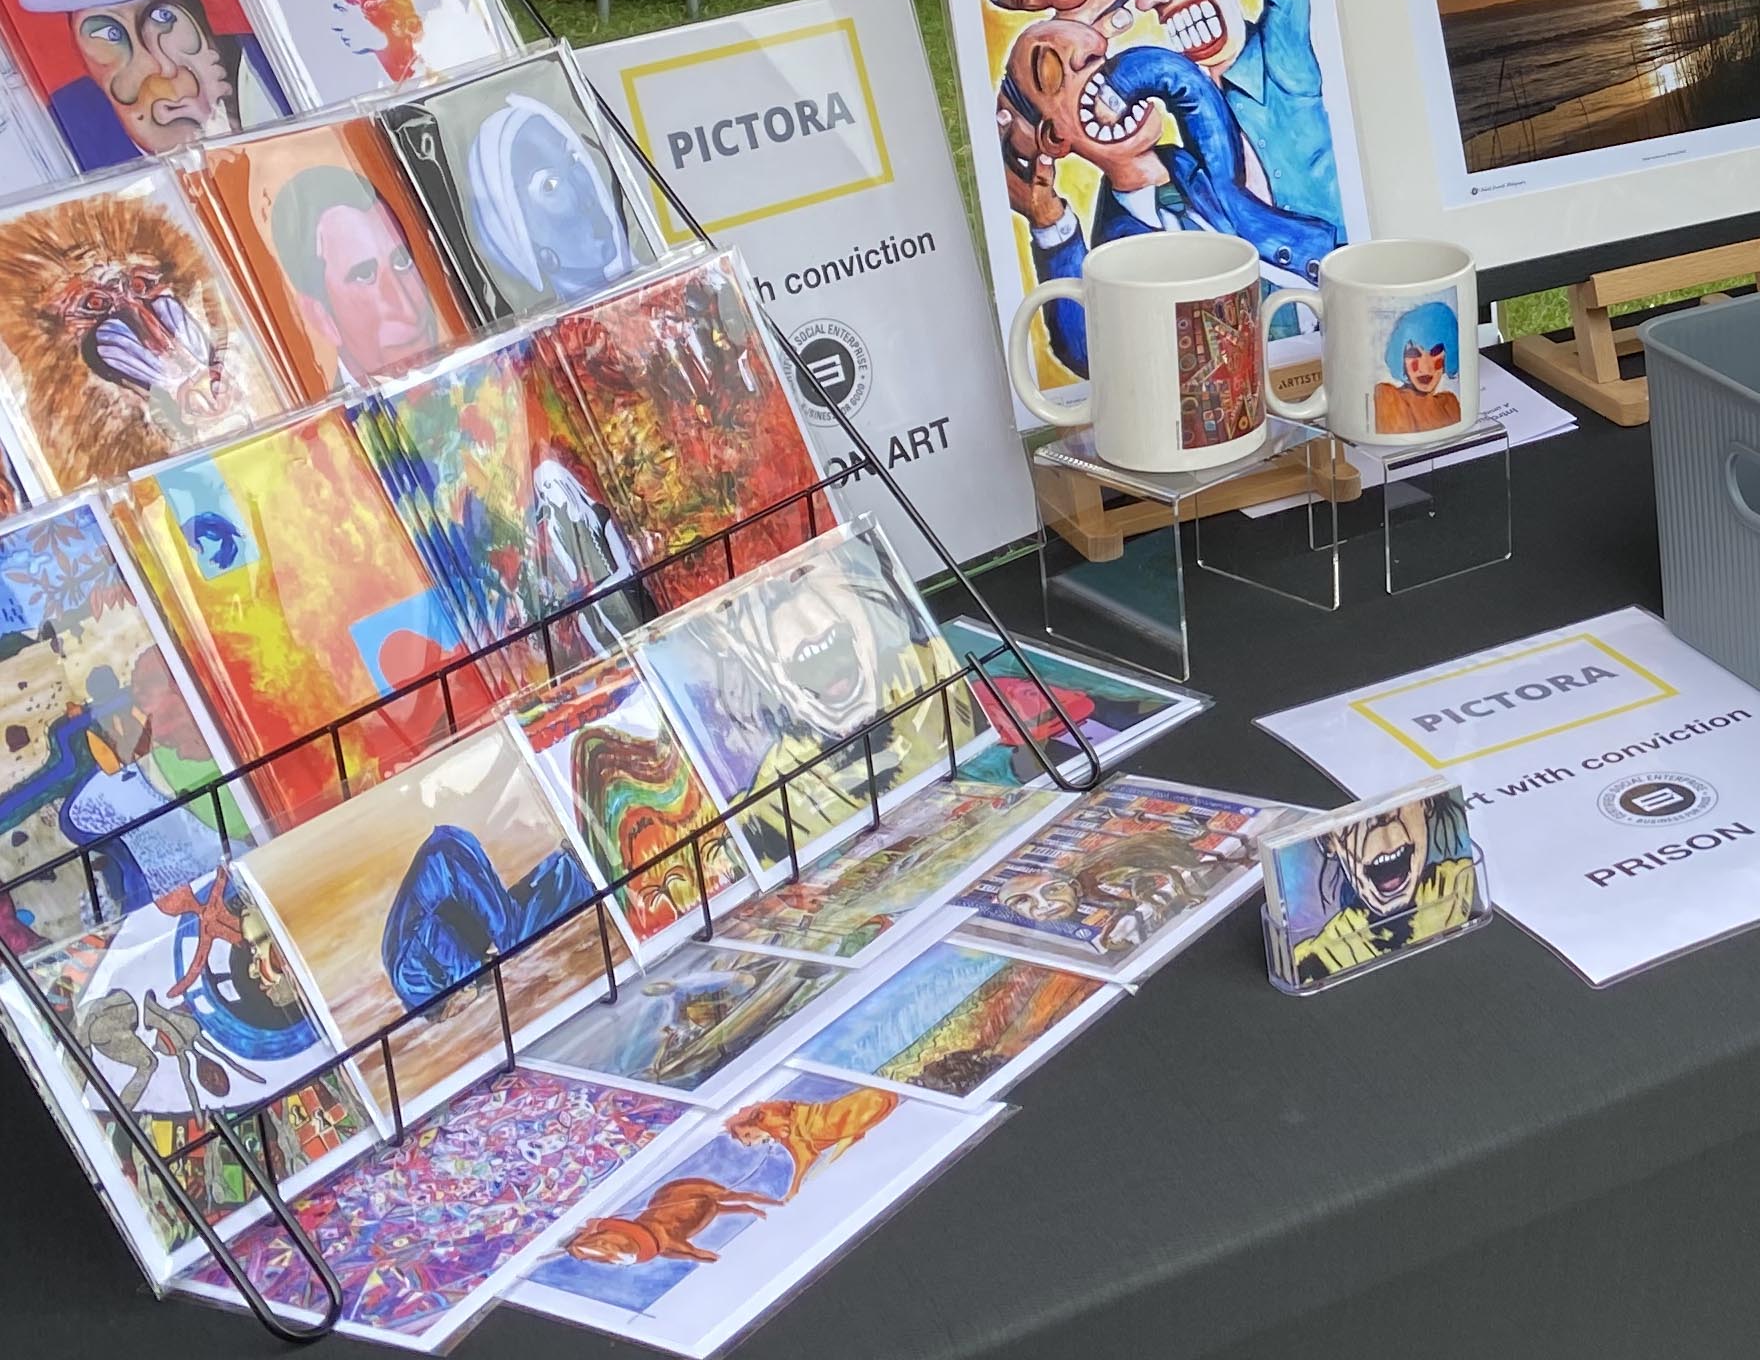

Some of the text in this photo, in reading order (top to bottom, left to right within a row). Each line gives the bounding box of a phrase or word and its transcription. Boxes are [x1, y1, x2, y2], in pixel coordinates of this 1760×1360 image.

[667, 91, 856, 169] PICTORA
[784, 230, 936, 295] conviction
[793, 324, 826, 346] SOCIAL
[827, 324, 868, 371] ENTERPRISE
[888, 417, 950, 470] ART
[1412, 663, 1620, 733] PICTORA
[1464, 706, 1752, 810] rt with conviction
[1585, 822, 1757, 887] PRISON
